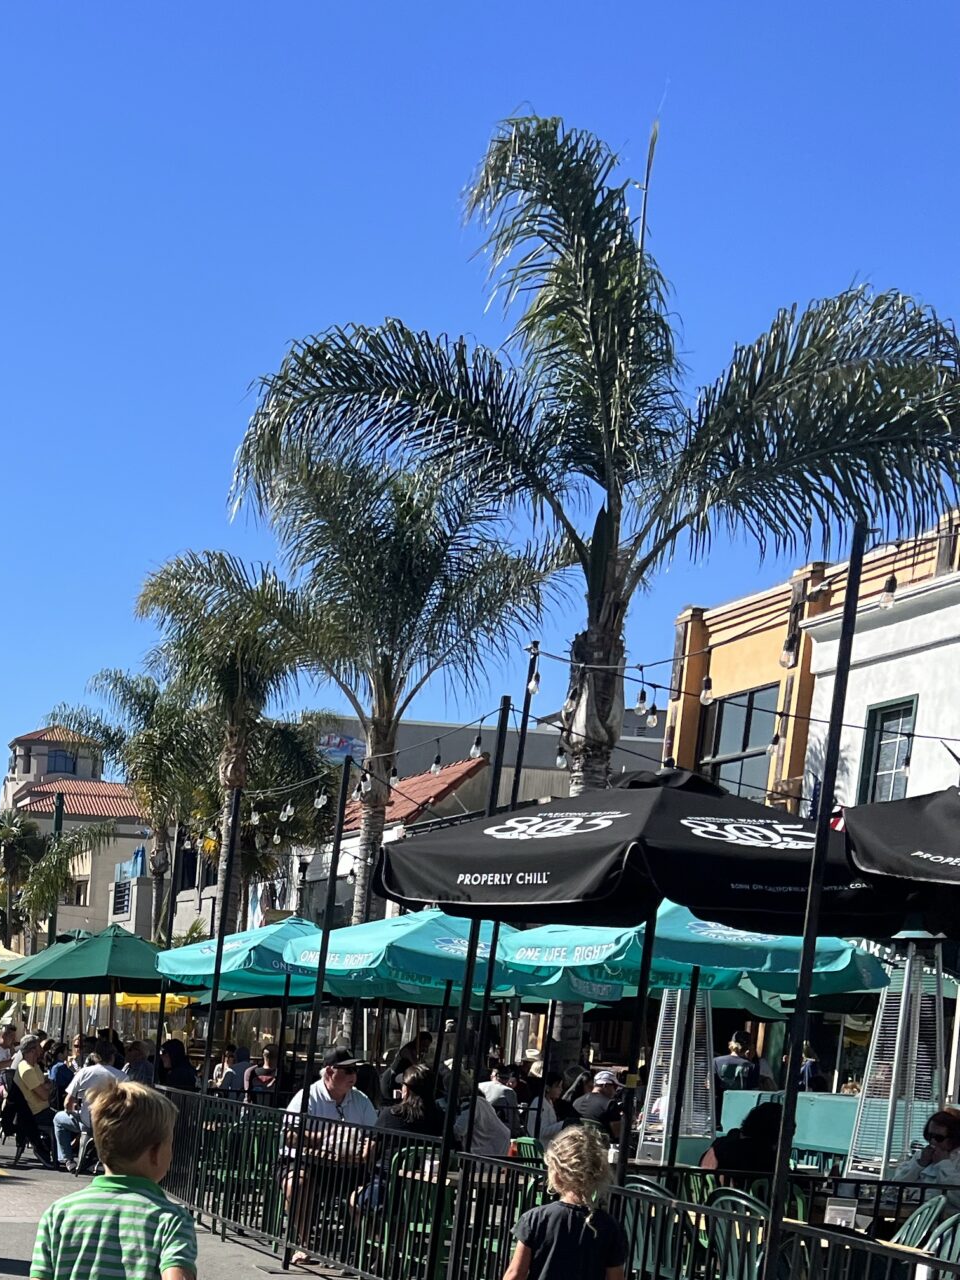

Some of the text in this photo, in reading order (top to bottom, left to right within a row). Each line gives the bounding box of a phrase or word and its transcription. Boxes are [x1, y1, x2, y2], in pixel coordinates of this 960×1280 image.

[483, 813, 632, 838] 805
[457, 872, 548, 885] PROPERLY CHILL
[515, 947, 541, 961] ONE
[272, 959, 294, 972] ONE
